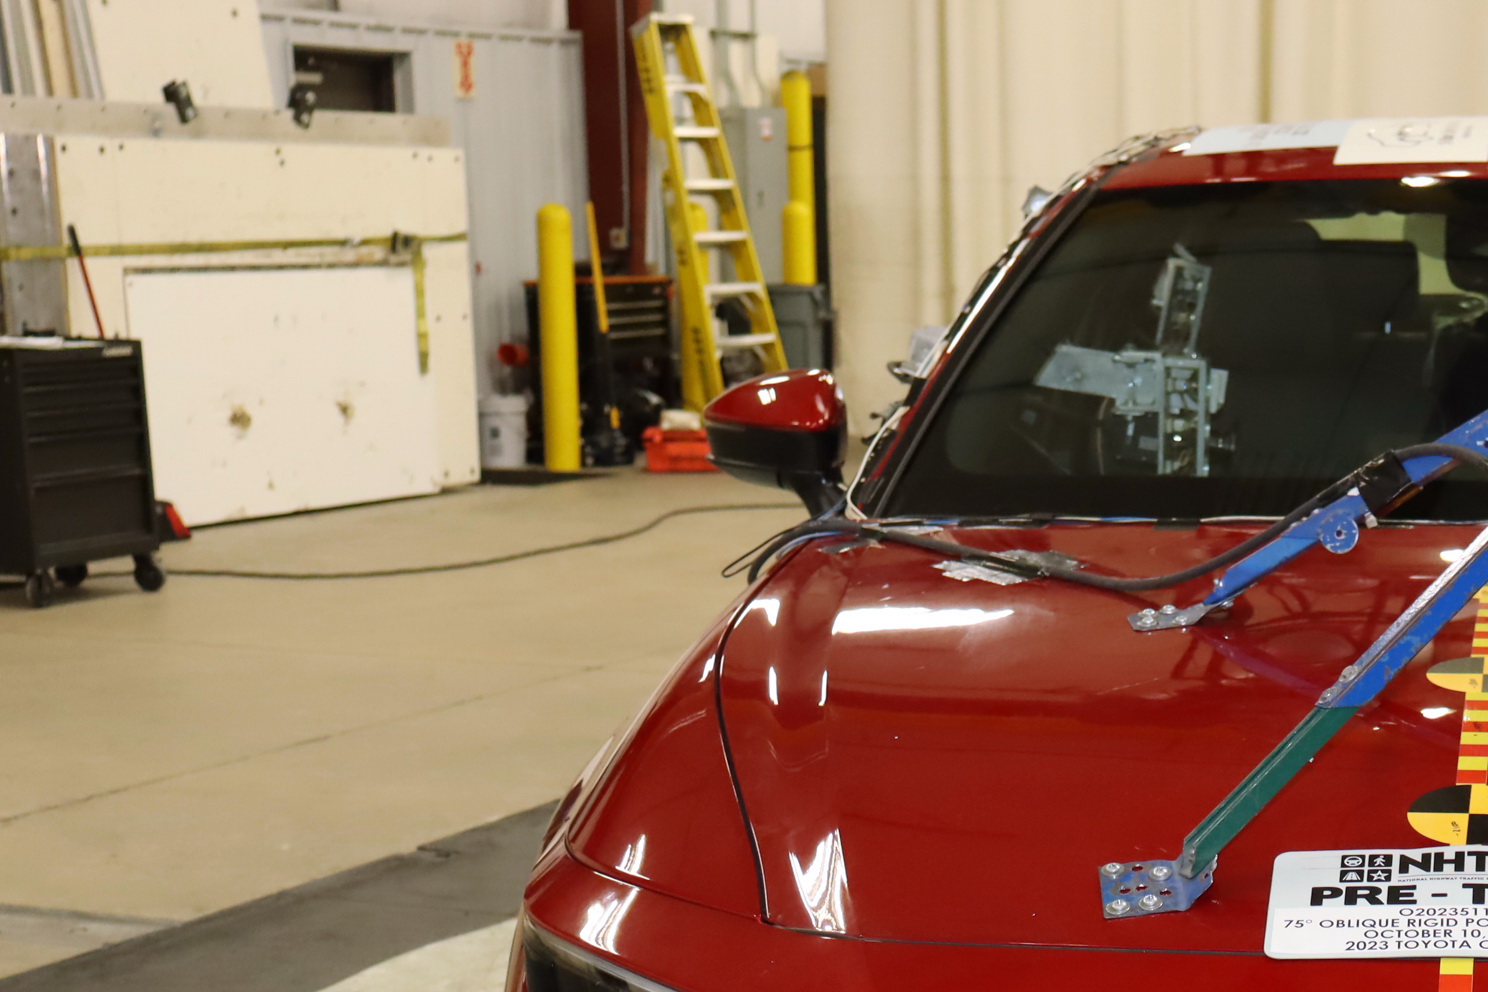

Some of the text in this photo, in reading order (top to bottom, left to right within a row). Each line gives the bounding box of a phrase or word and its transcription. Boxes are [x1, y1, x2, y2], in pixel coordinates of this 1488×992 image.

[1309, 884, 1418, 907] PRE
[1284, 919, 1313, 929] 75°
[1319, 918, 1400, 929] OBLIQUE
[1407, 918, 1458, 928] RIGID
[1363, 929, 1453, 939] OCTOBER
[1461, 928, 1486, 940] 10,
[1345, 940, 1389, 951] 2023
[1395, 939, 1472, 950] TOYOTA
